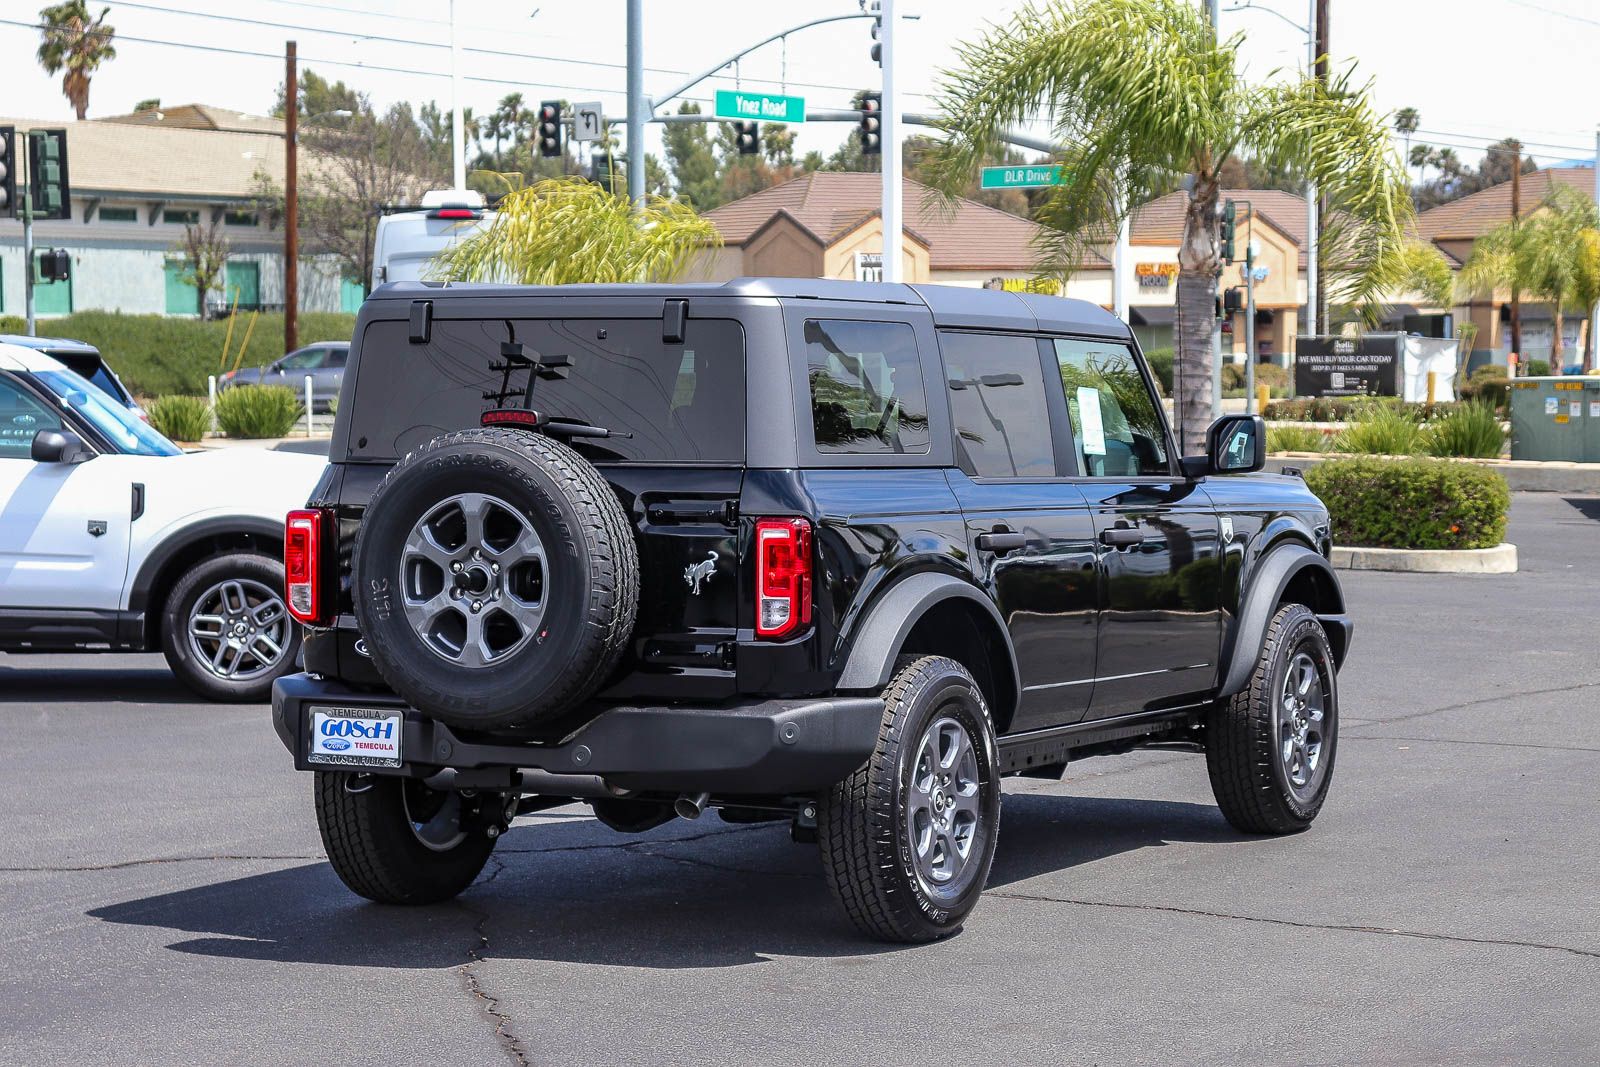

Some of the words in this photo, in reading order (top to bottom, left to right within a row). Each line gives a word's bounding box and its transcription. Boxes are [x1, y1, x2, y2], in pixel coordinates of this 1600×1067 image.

[736, 95, 760, 115] Ynez
[761, 97, 786, 117] Road
[1005, 170, 1024, 182] DLR
[1027, 169, 1051, 181] Drive
[1299, 355, 1310, 363] WE
[1310, 355, 1324, 363] WILL
[1325, 355, 1338, 363] BUY
[1338, 355, 1355, 363] YOUR
[1356, 355, 1370, 363] CAR
[1370, 355, 1392, 363] TODAY
[332, 708, 380, 718] TEMECULA
[354, 742, 394, 750] TEMECULA
